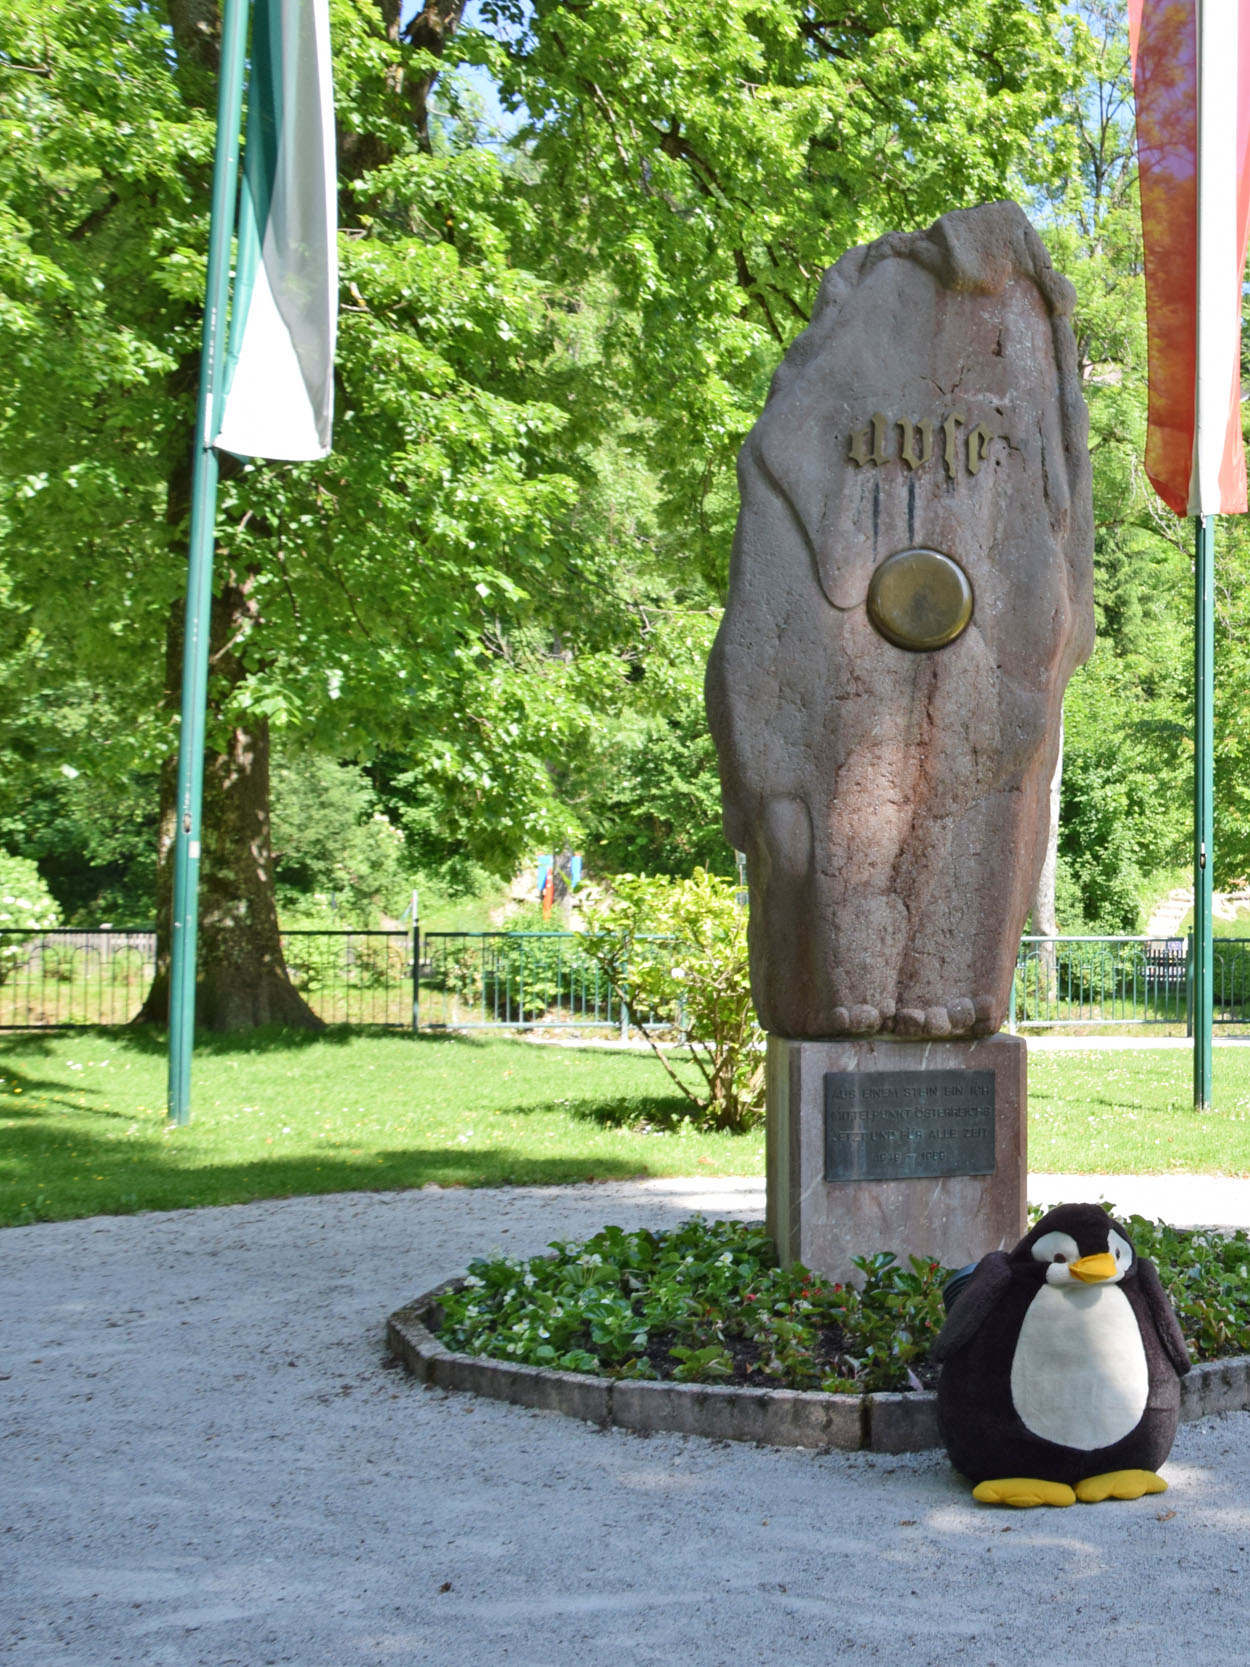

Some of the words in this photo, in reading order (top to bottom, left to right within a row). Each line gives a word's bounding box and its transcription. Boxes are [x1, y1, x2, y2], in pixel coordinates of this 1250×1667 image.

[832, 1089, 856, 1099] AUS
[862, 1088, 899, 1099] EINEM
[903, 1087, 938, 1097] STEIN
[869, 1130, 898, 1140] UND
[928, 1128, 957, 1139] ALLE
